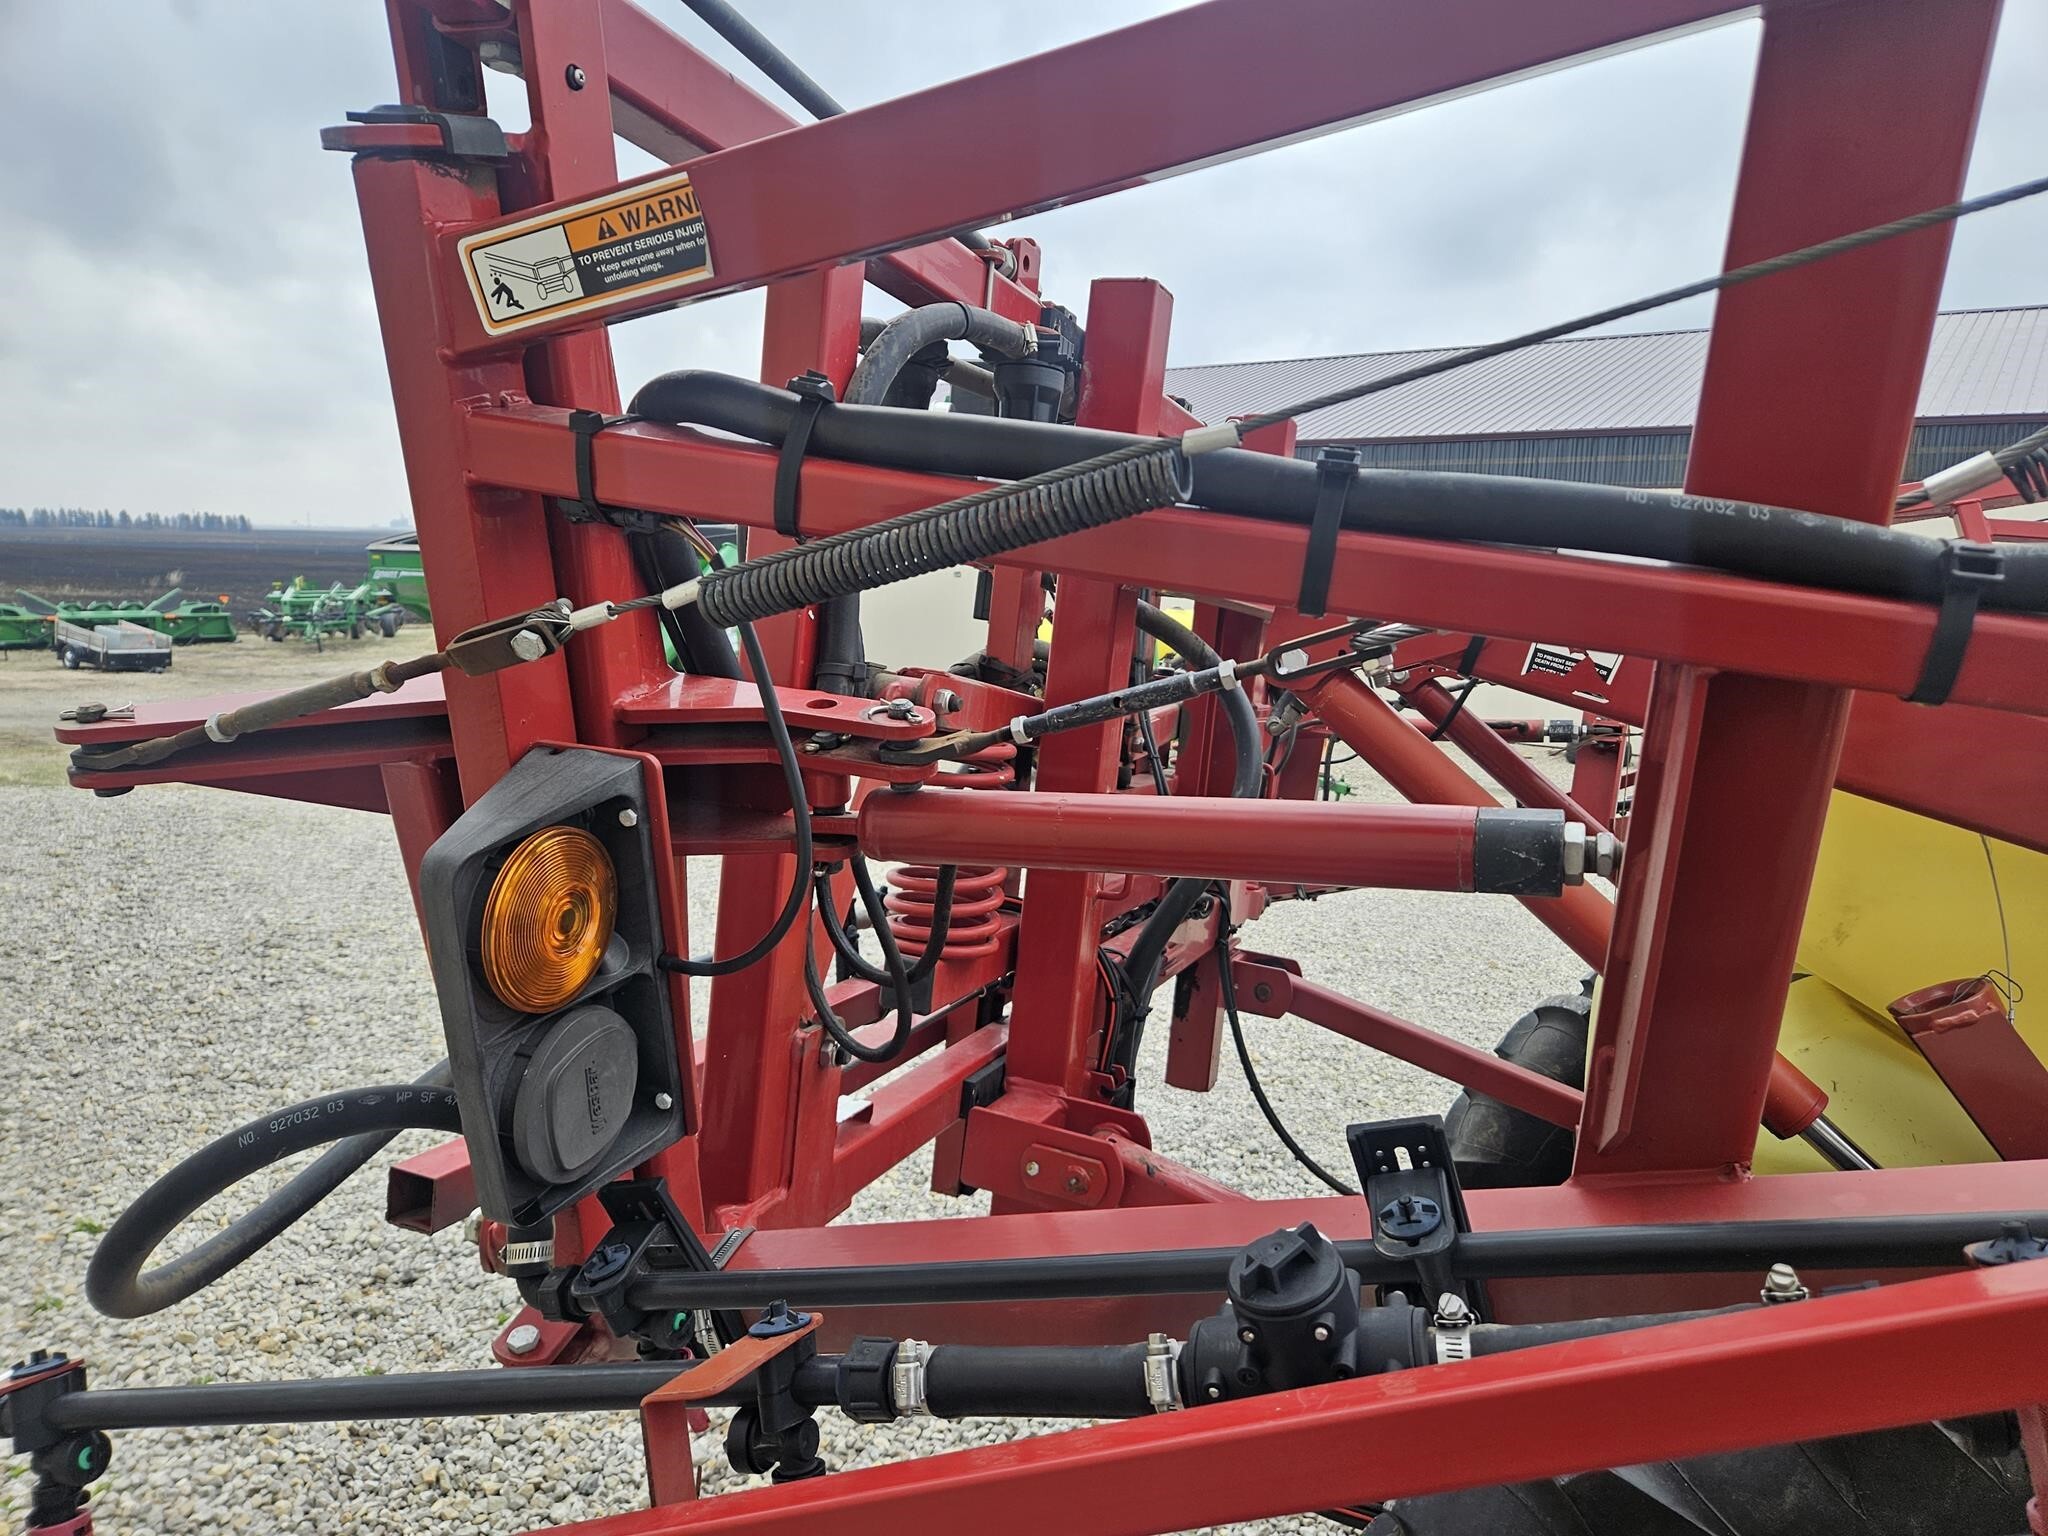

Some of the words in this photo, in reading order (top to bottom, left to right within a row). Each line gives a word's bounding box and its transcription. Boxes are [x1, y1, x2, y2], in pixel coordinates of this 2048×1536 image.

[578, 255, 592, 266] TO
[592, 242, 633, 262] PREVENT
[634, 230, 675, 250] SERIOUS
[675, 221, 705, 239] INJUR
[600, 260, 620, 274] Keep
[621, 250, 655, 268] everyone
[656, 245, 674, 258] away
[675, 240, 696, 252] when
[697, 235, 706, 246] fo
[604, 266, 639, 284] unfolding
[640, 260, 664, 274] wings.
[1669, 494, 1736, 516] 927032
[1748, 505, 1770, 521] 03
[1543, 654, 1566, 665] PREVENT
[238, 1131, 260, 1149] NO.
[269, 1105, 320, 1133] 927032
[327, 1099, 345, 1114] 03
[396, 1090, 413, 1104] WP
[420, 1091, 437, 1104] SF
